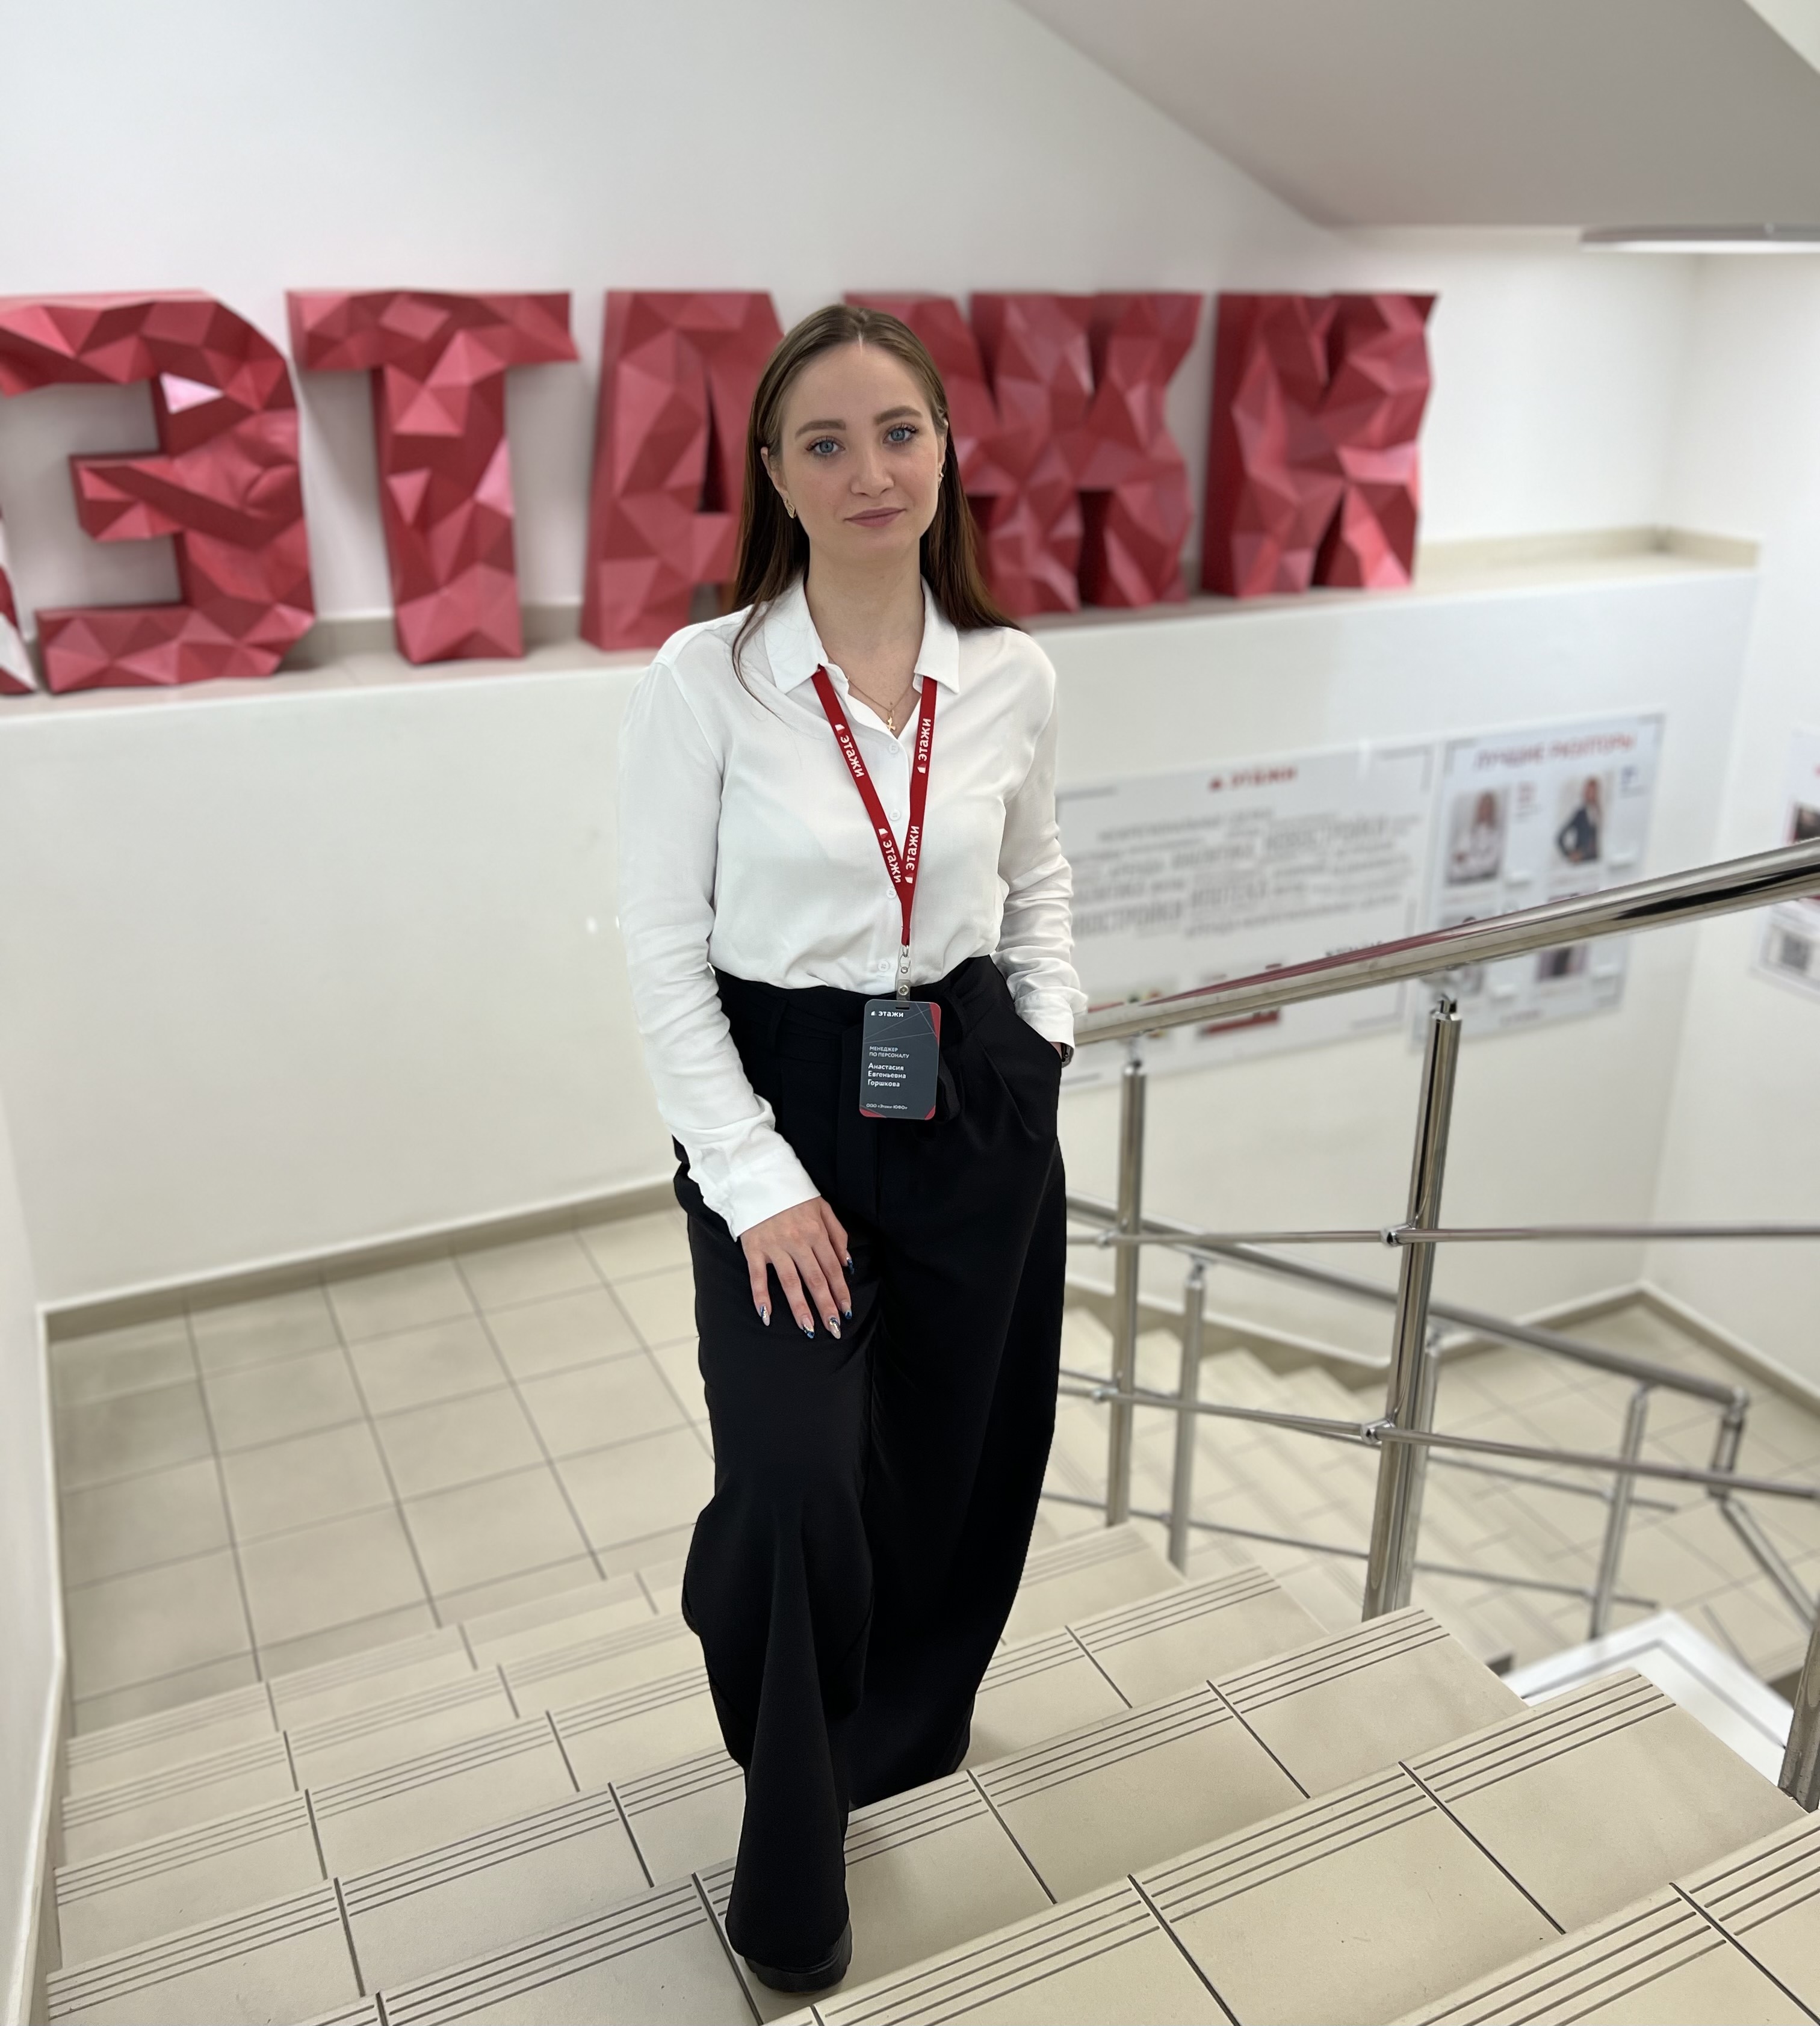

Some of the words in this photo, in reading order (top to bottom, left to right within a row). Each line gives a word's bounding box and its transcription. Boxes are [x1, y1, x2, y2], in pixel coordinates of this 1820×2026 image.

[840, 734, 864, 777] этажи
[918, 718, 932, 761] этажи
[882, 839, 901, 883] этажи
[905, 826, 920, 870] этажи
[868, 1063, 904, 1071] Анастасия
